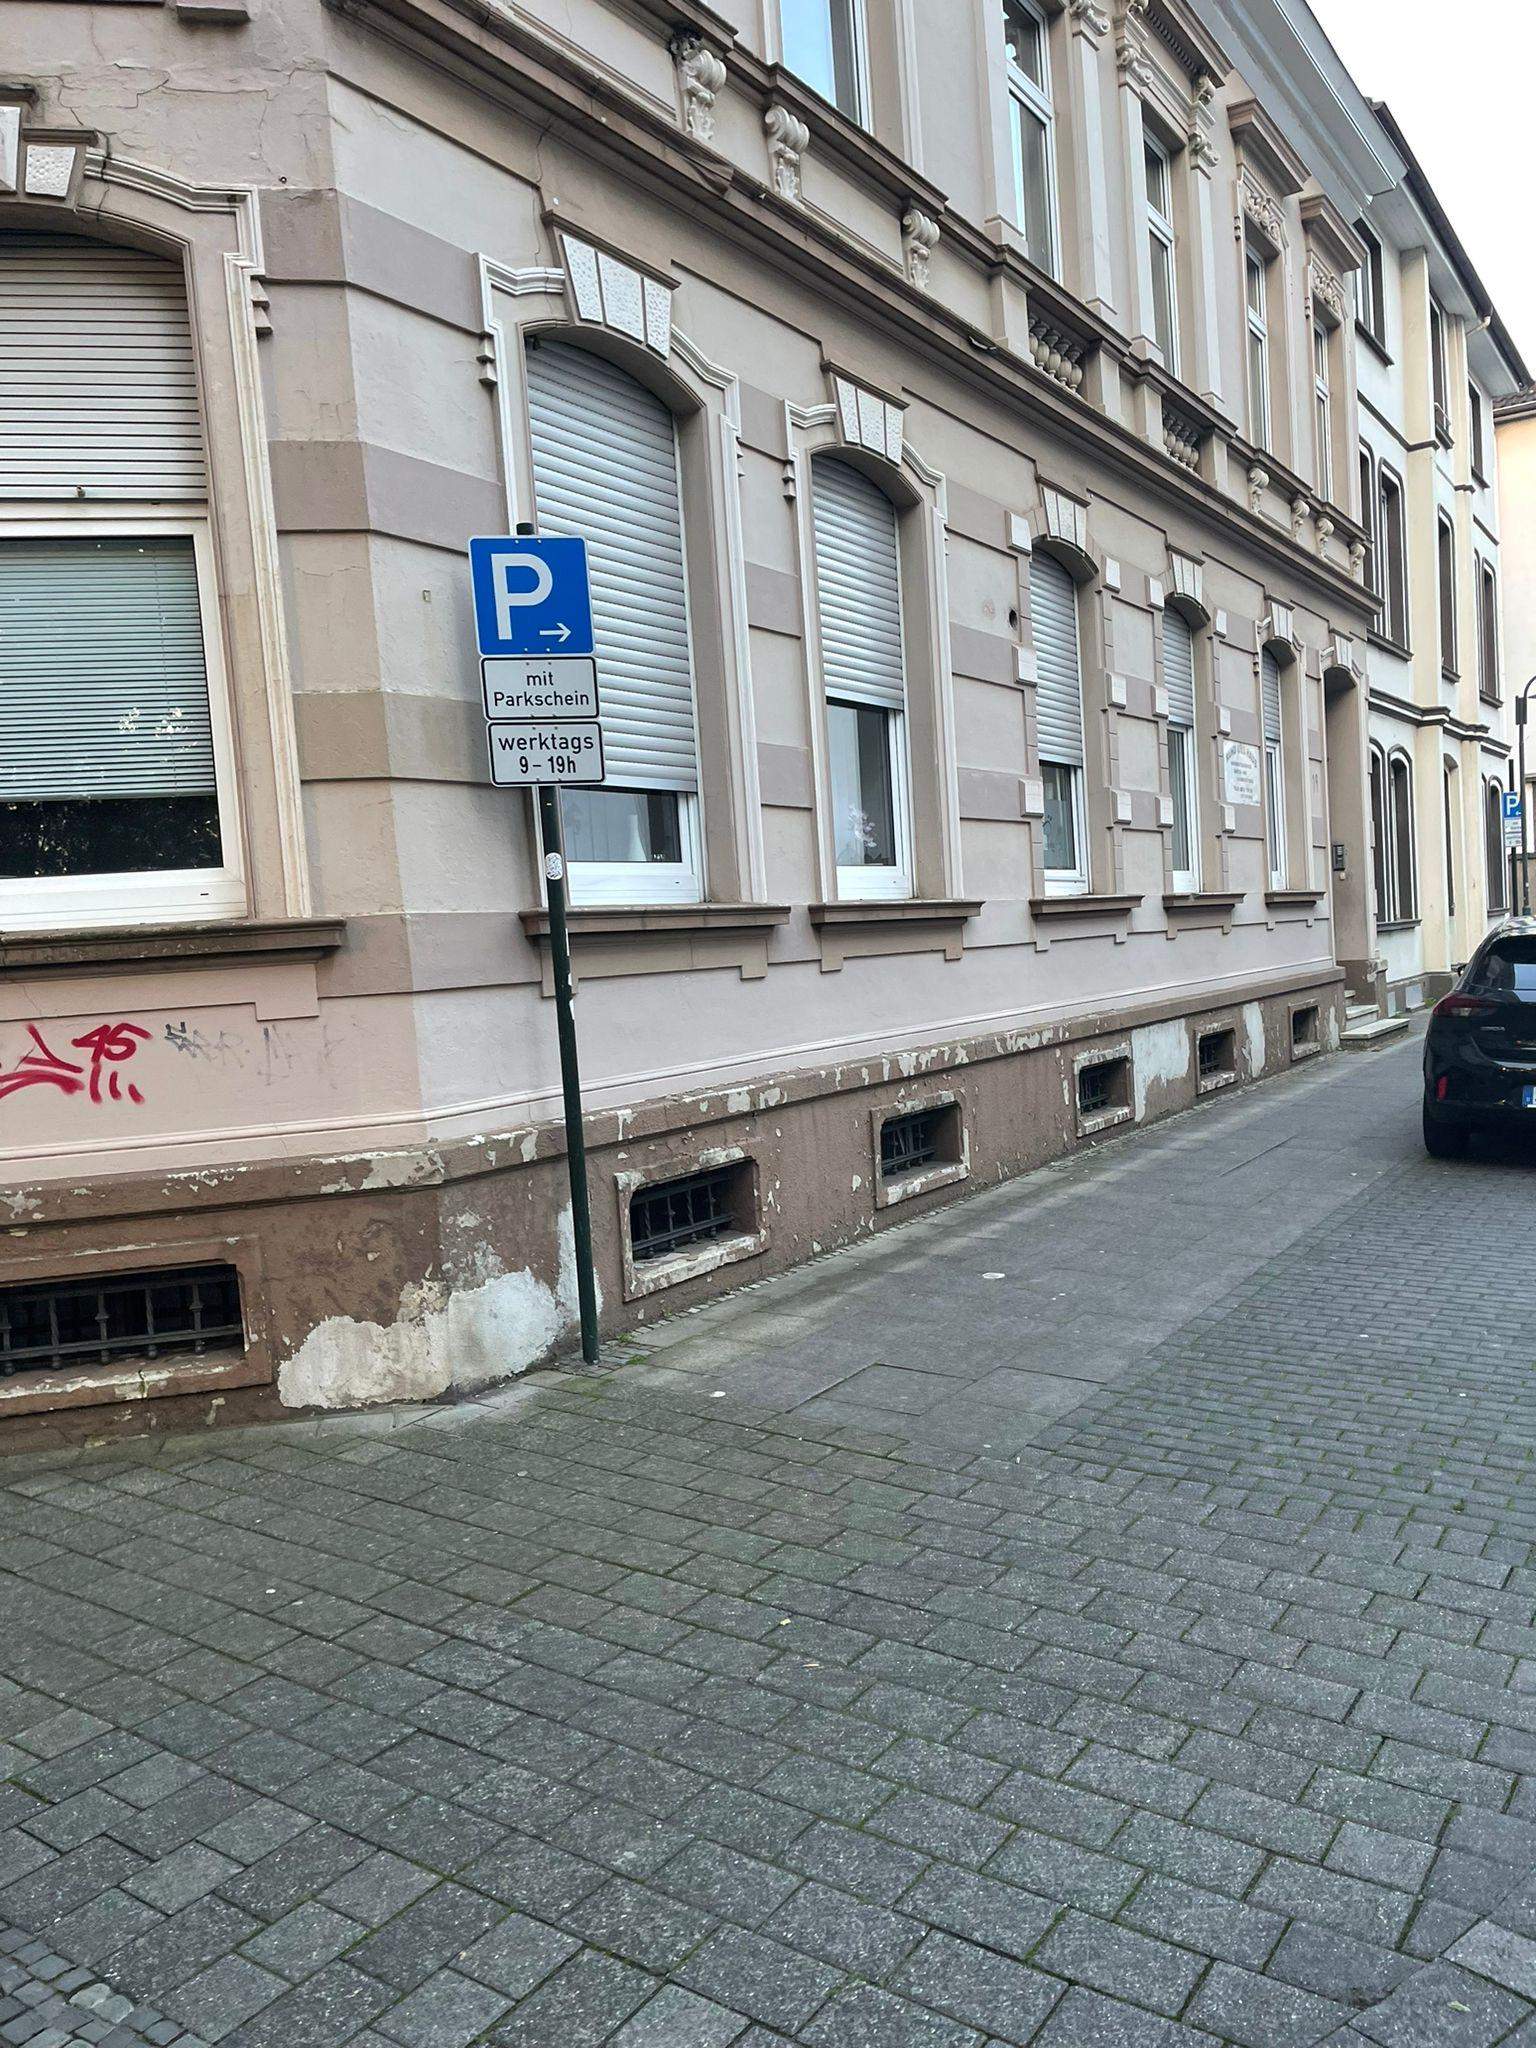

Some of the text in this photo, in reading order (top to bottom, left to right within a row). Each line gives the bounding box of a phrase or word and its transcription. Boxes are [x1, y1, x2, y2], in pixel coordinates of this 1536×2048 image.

[491, 553, 553, 640] P
[526, 671, 554, 686] mit
[494, 691, 589, 707] Parkschein
[498, 733, 594, 754] werktags
[519, 756, 529, 774] 9
[547, 755, 576, 774] 19h
[1506, 795, 1520, 815] P
